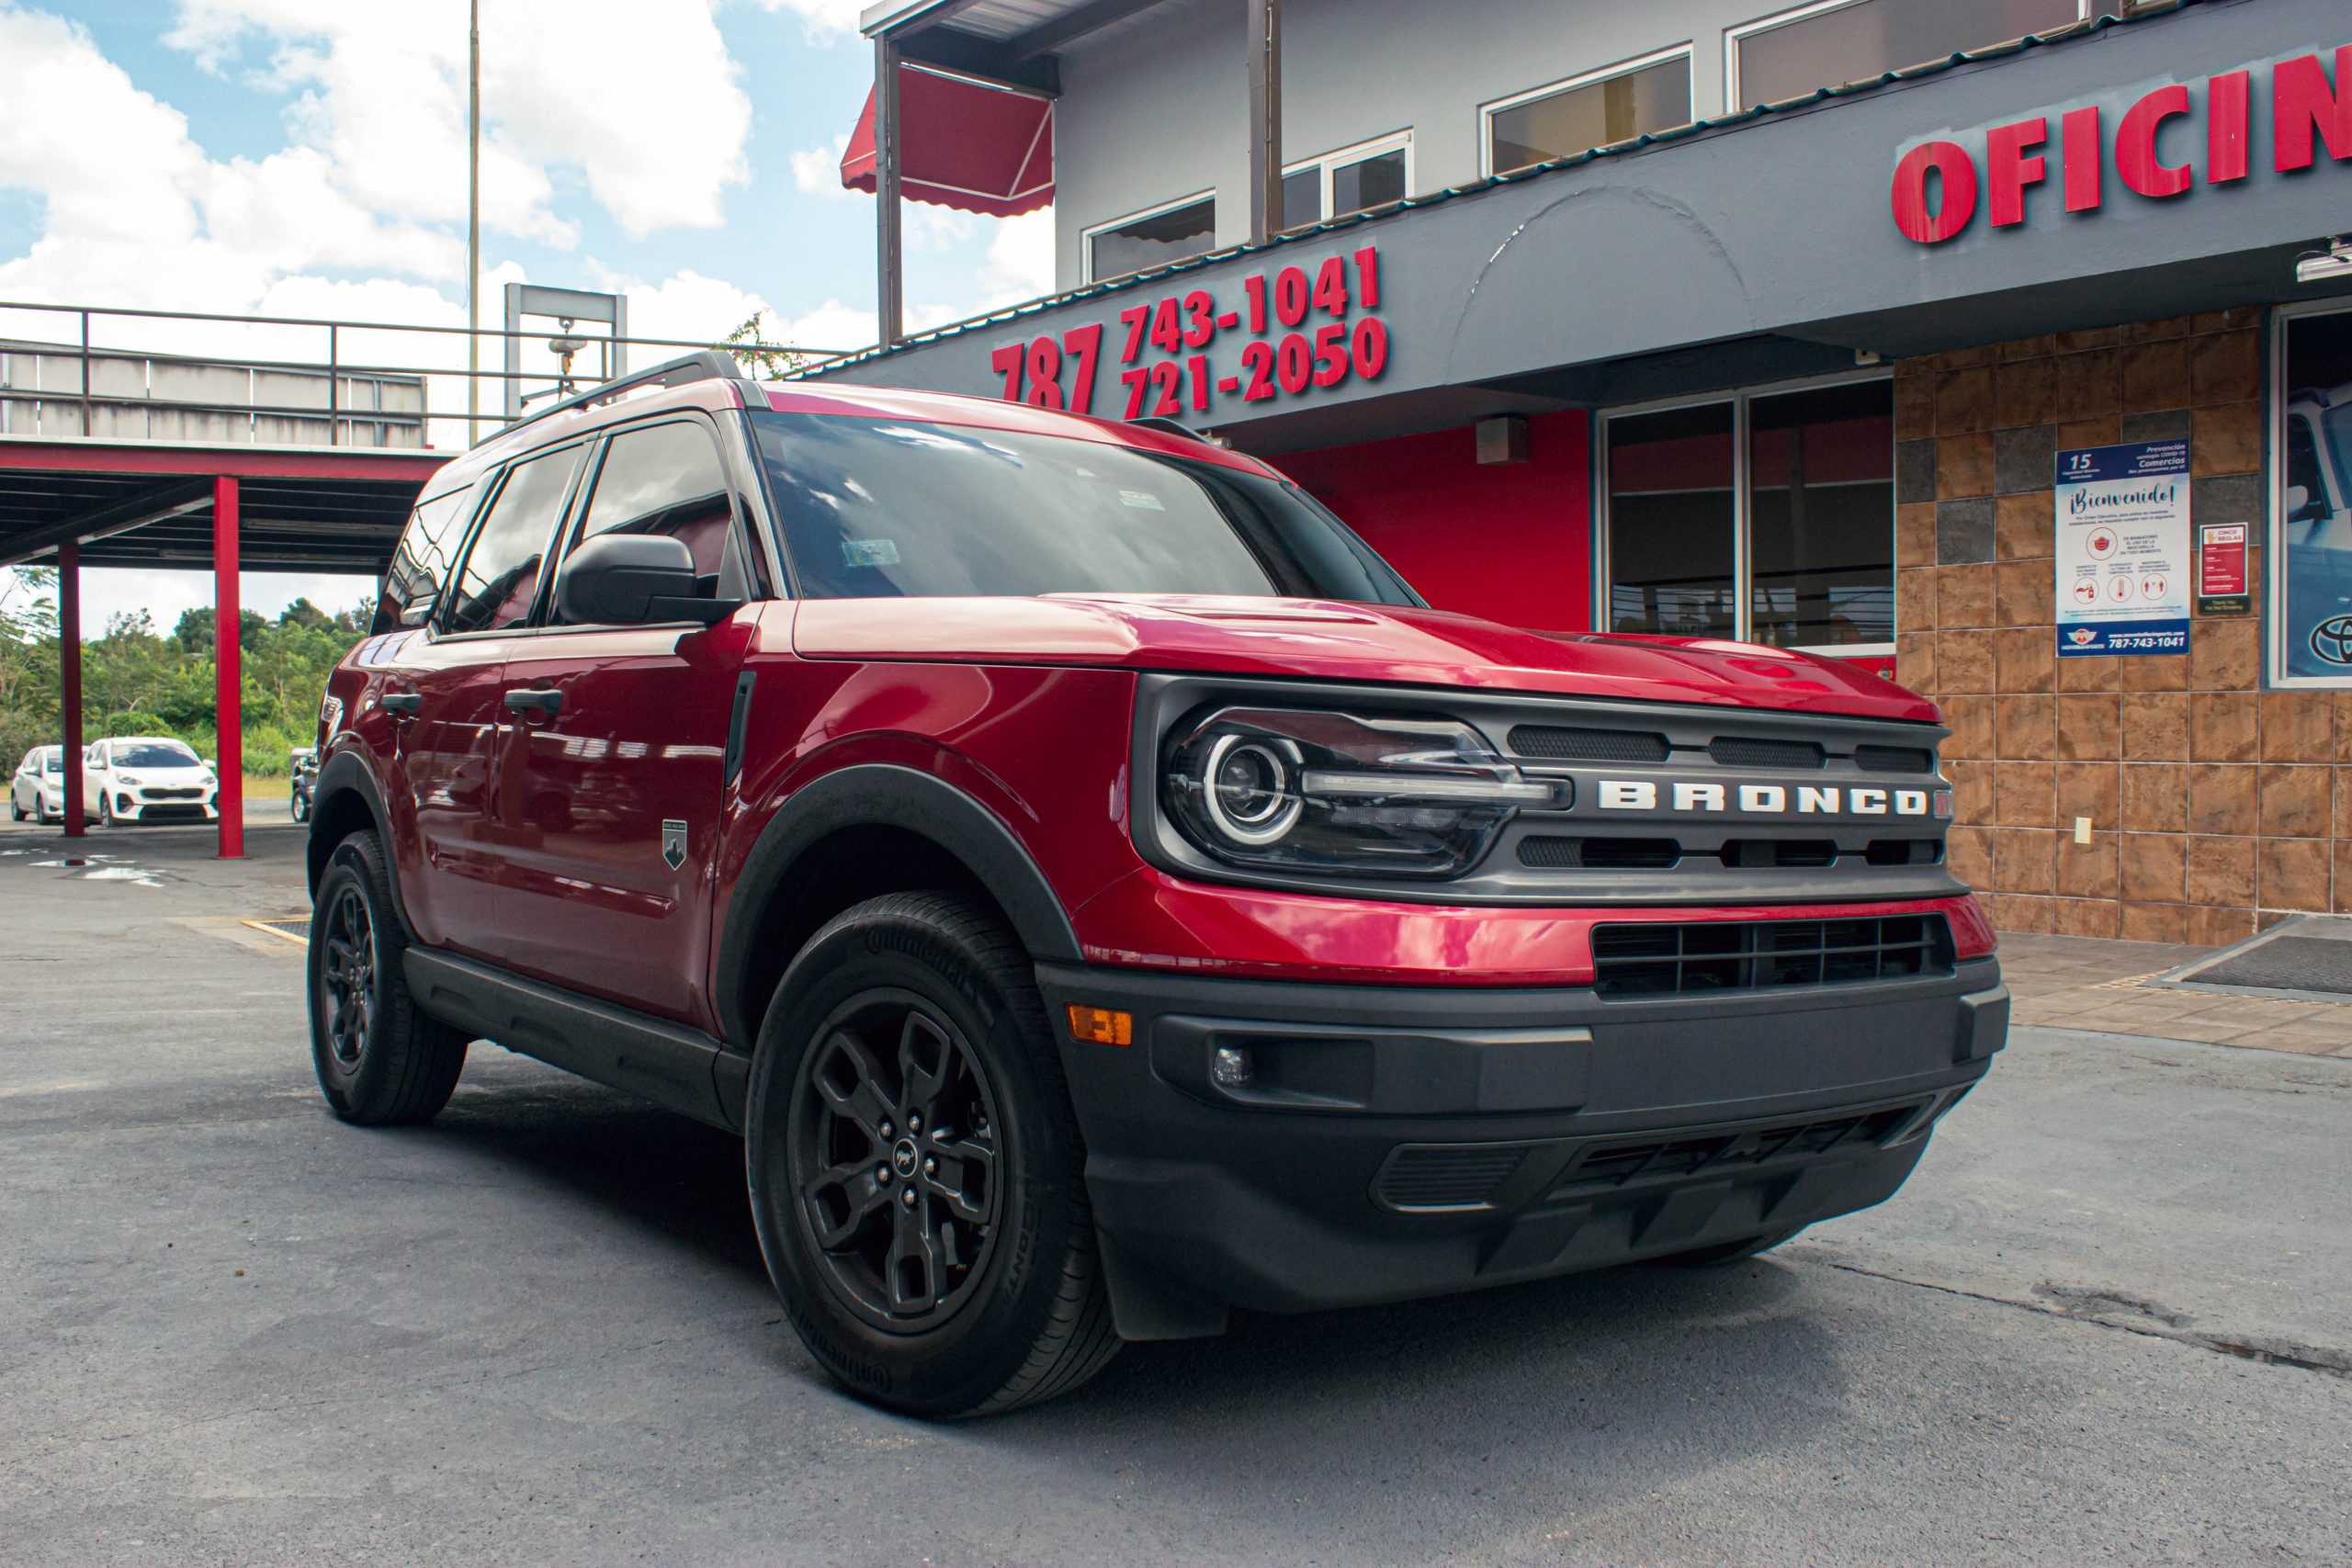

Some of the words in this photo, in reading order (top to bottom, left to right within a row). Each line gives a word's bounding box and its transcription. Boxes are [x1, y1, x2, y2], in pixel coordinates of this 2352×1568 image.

[1892, 43, 2352, 243] OFICIN
[1121, 246, 1377, 365] 743-1041
[991, 323, 1102, 415] 787
[1121, 316, 1387, 421] 721-2050
[2070, 454, 2092, 470] 15
[2139, 457, 2186, 468] Comercios
[2070, 482, 2176, 514] ¡Bienvenido!
[2109, 637, 2184, 649] 787-743-1041
[1598, 781, 1927, 815] BRONCO
